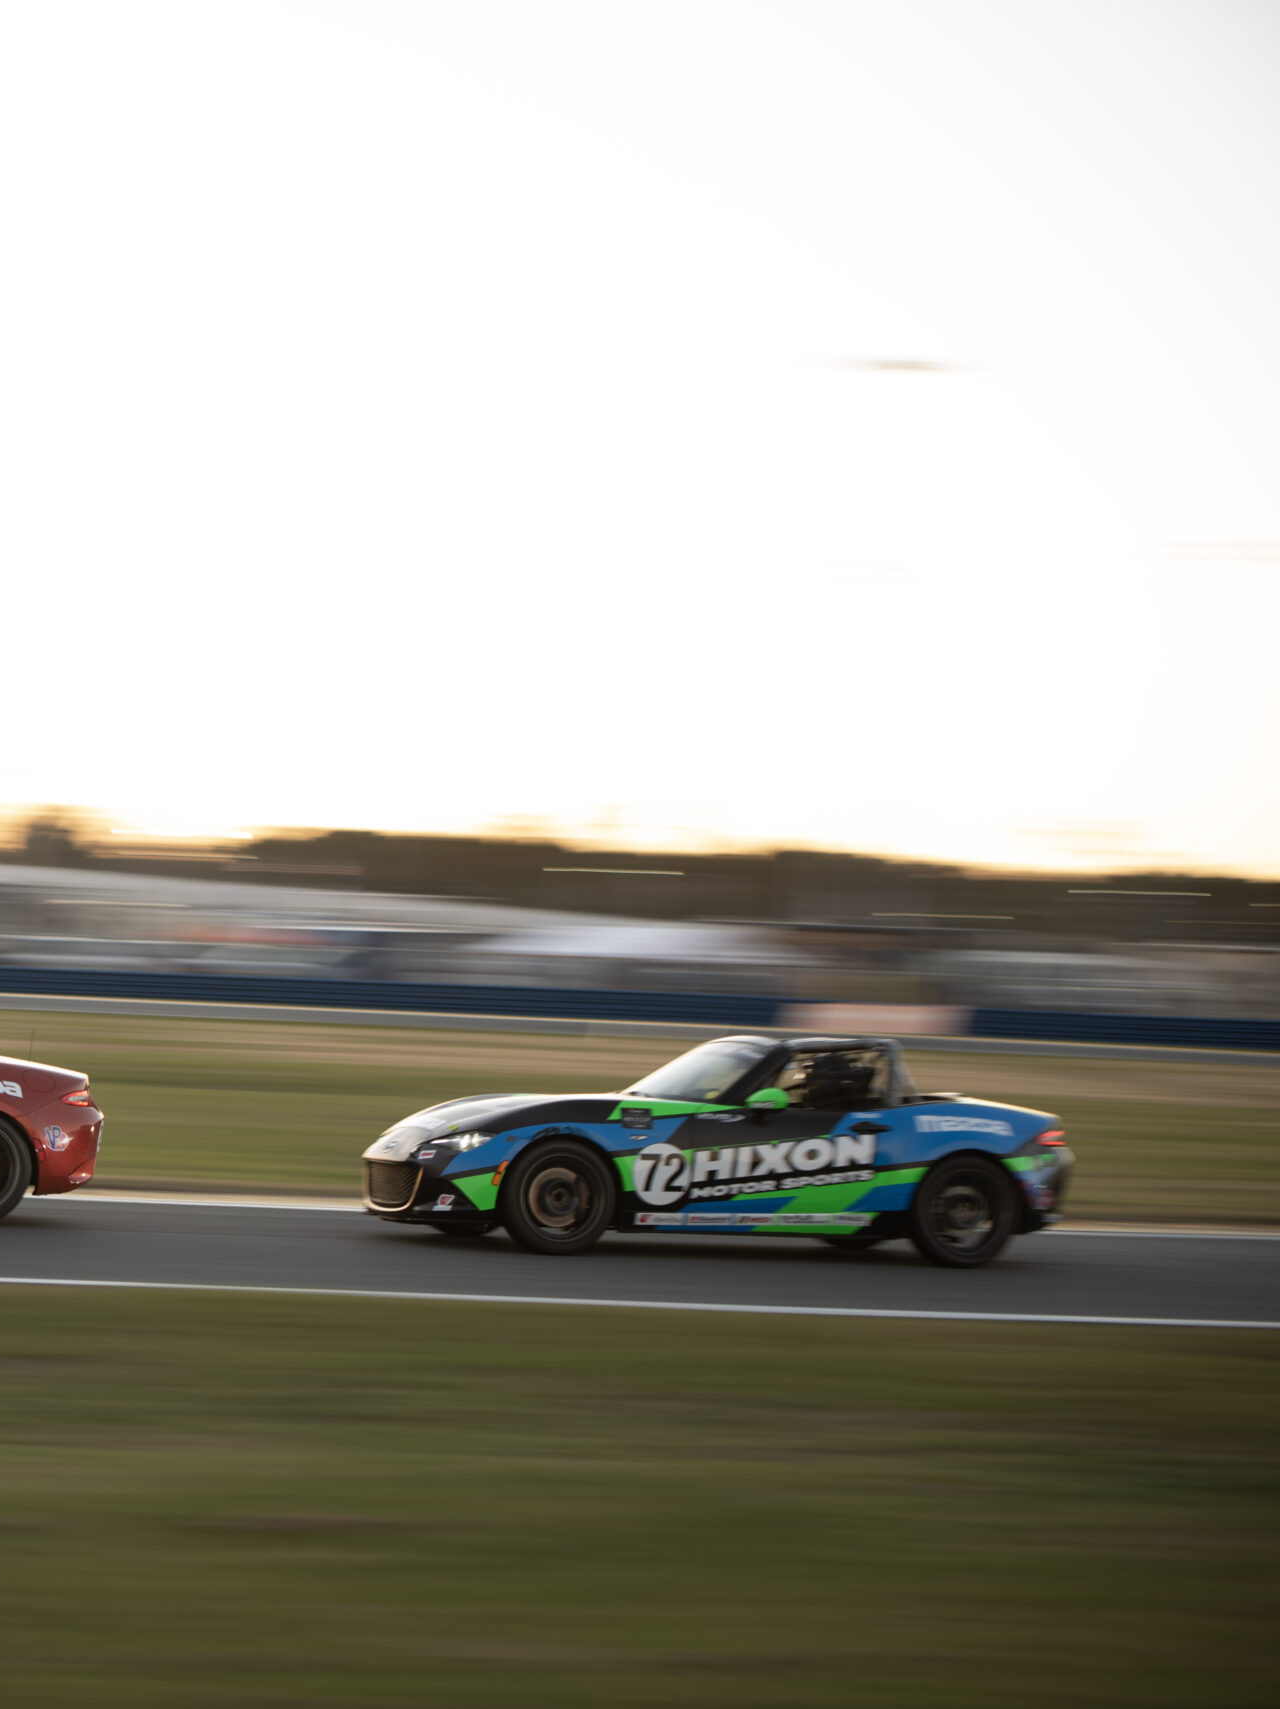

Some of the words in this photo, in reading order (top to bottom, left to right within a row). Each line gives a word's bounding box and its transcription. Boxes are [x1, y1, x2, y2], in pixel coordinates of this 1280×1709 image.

[639, 1153, 687, 1193] 72
[692, 1133, 877, 1182] HIXON
[689, 1179, 778, 1199] MOTOR
[778, 1169, 875, 1190] SPORTS
